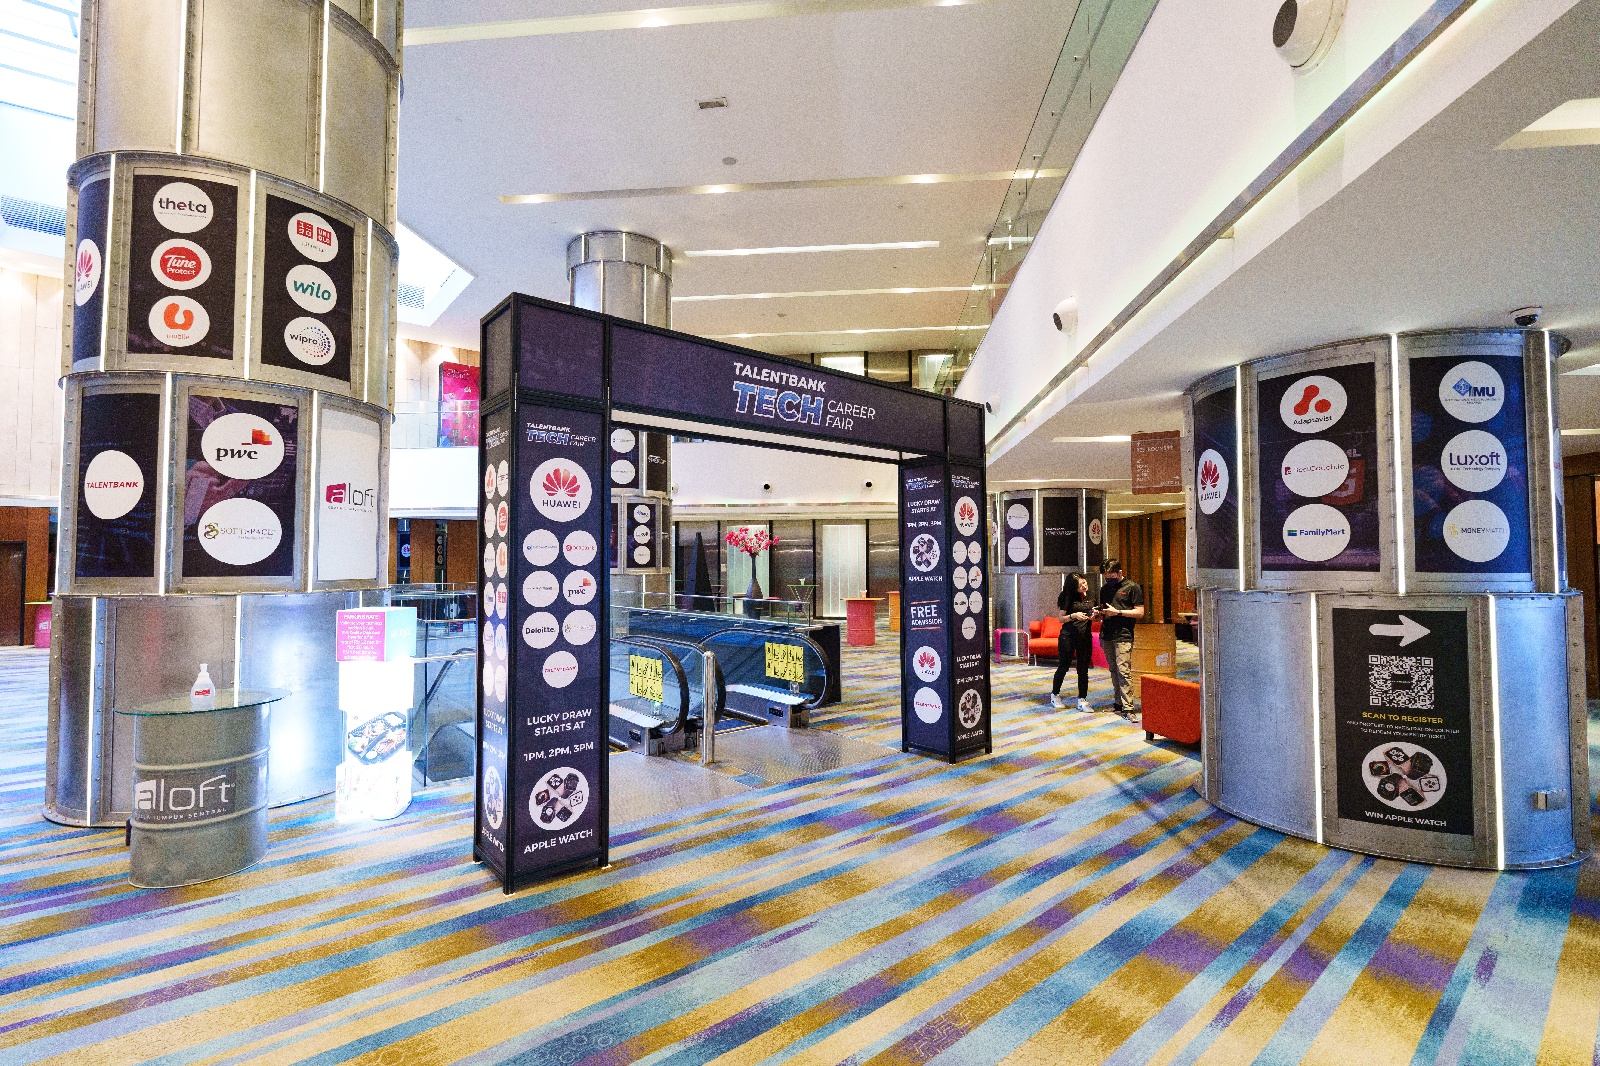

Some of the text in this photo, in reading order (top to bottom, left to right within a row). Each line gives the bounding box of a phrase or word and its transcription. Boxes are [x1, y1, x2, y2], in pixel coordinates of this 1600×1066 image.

[159, 197, 207, 213] theta
[164, 254, 197, 268] Tune
[166, 267, 196, 276] Protect
[293, 279, 332, 301] wilo
[289, 332, 318, 348] wipro
[734, 362, 827, 392] TALENTBANK
[732, 380, 876, 426] TECH CAREER
[526, 422, 571, 433] TALENTBANK
[825, 414, 853, 431] FAIR
[1293, 415, 1332, 426] Adaptavist
[526, 429, 597, 446] TECH CAREER
[215, 447, 258, 461] pwc
[1449, 452, 1500, 466] Luxoft
[86, 481, 139, 489] TALENTBANK
[325, 483, 374, 507] aloft
[542, 500, 581, 509] HUAWEI
[1299, 528, 1345, 537] FamilyMart
[568, 588, 586, 598] pwc
[910, 604, 938, 619] FREE
[911, 618, 942, 626] ADMISSION
[527, 708, 592, 726] LUCKY DRAW
[1361, 711, 1386, 720] SCAN
[1401, 715, 1444, 724] REGISTER
[534, 721, 586, 737] STARTS AT
[523, 742, 594, 762] 1PM, 2PM, 3PM
[135, 774, 230, 811] aloft
[1364, 810, 1447, 827] WIN APPLE WATCH
[523, 828, 593, 855] APPLE WATCH
